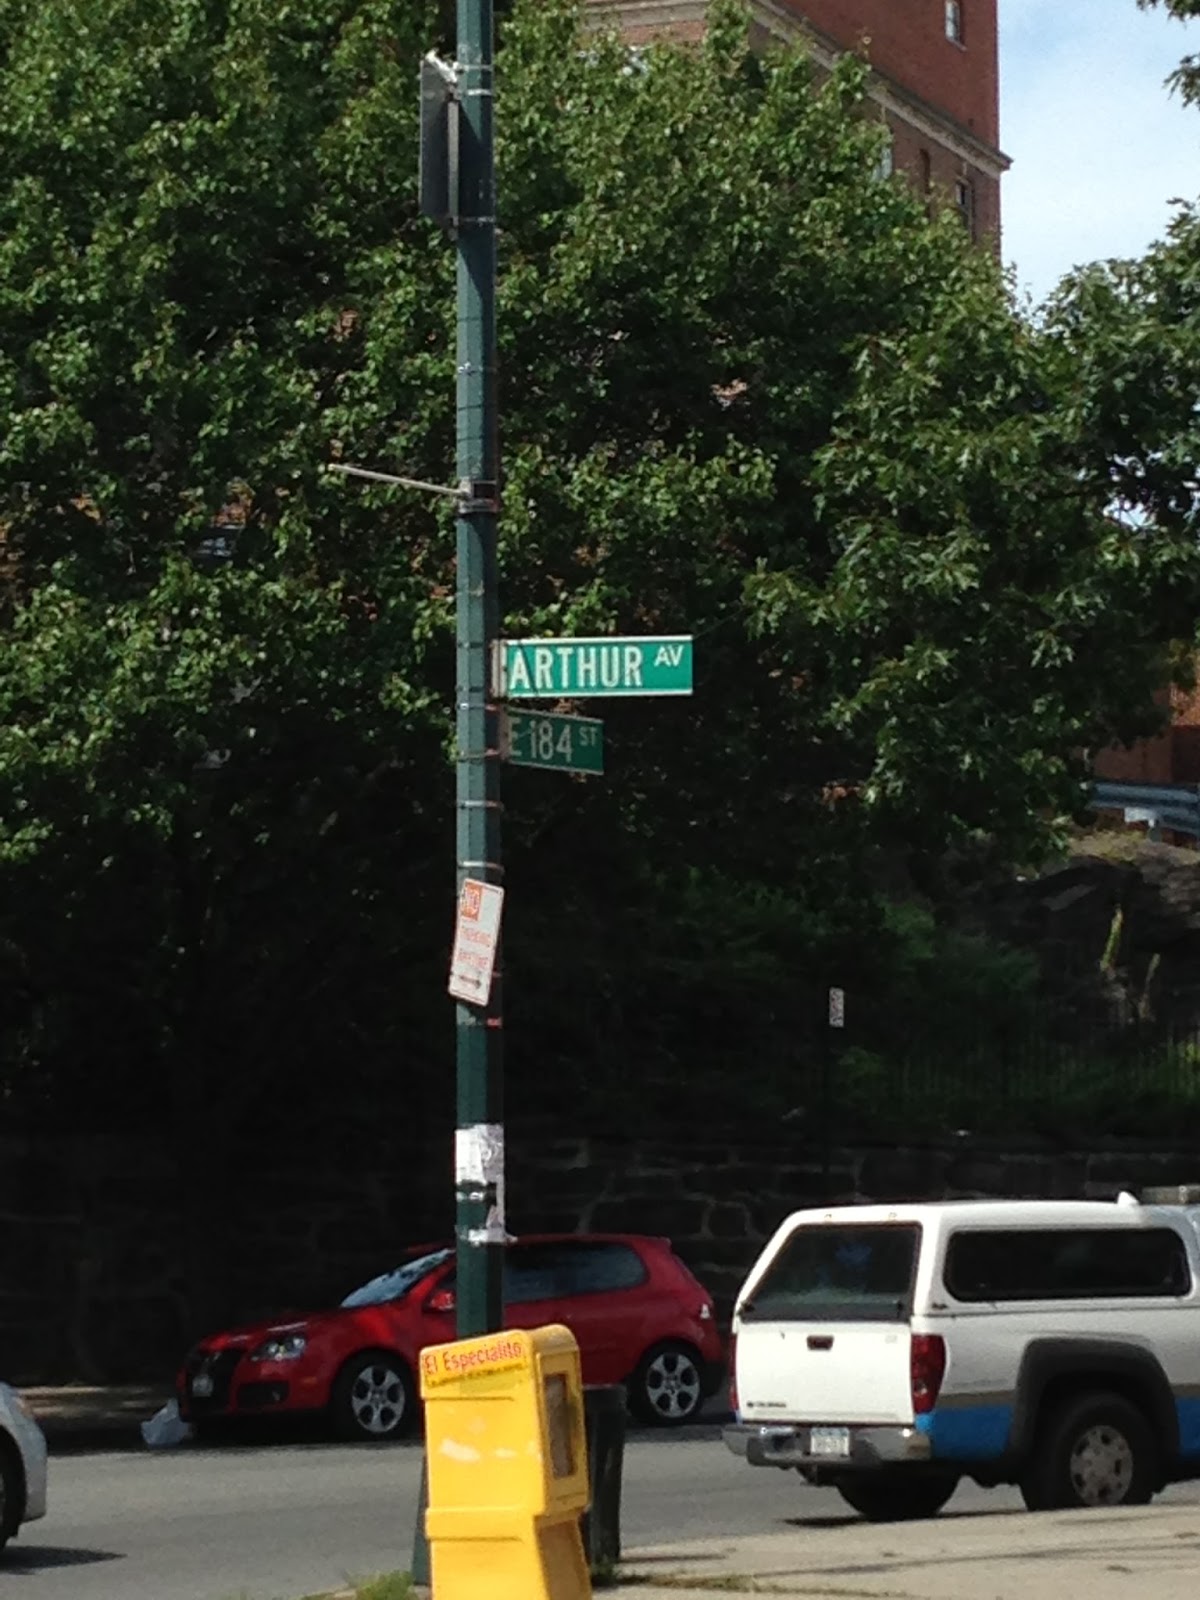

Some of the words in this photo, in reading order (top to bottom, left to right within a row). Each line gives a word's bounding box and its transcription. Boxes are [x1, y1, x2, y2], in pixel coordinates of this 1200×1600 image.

[509, 646, 643, 690] ARTHUR
[654, 645, 685, 667] AV
[508, 717, 522, 757] E
[529, 720, 572, 763] 184
[579, 726, 597, 747] ST
[424, 1353, 438, 1375] El
[443, 1341, 522, 1372] Especialito
